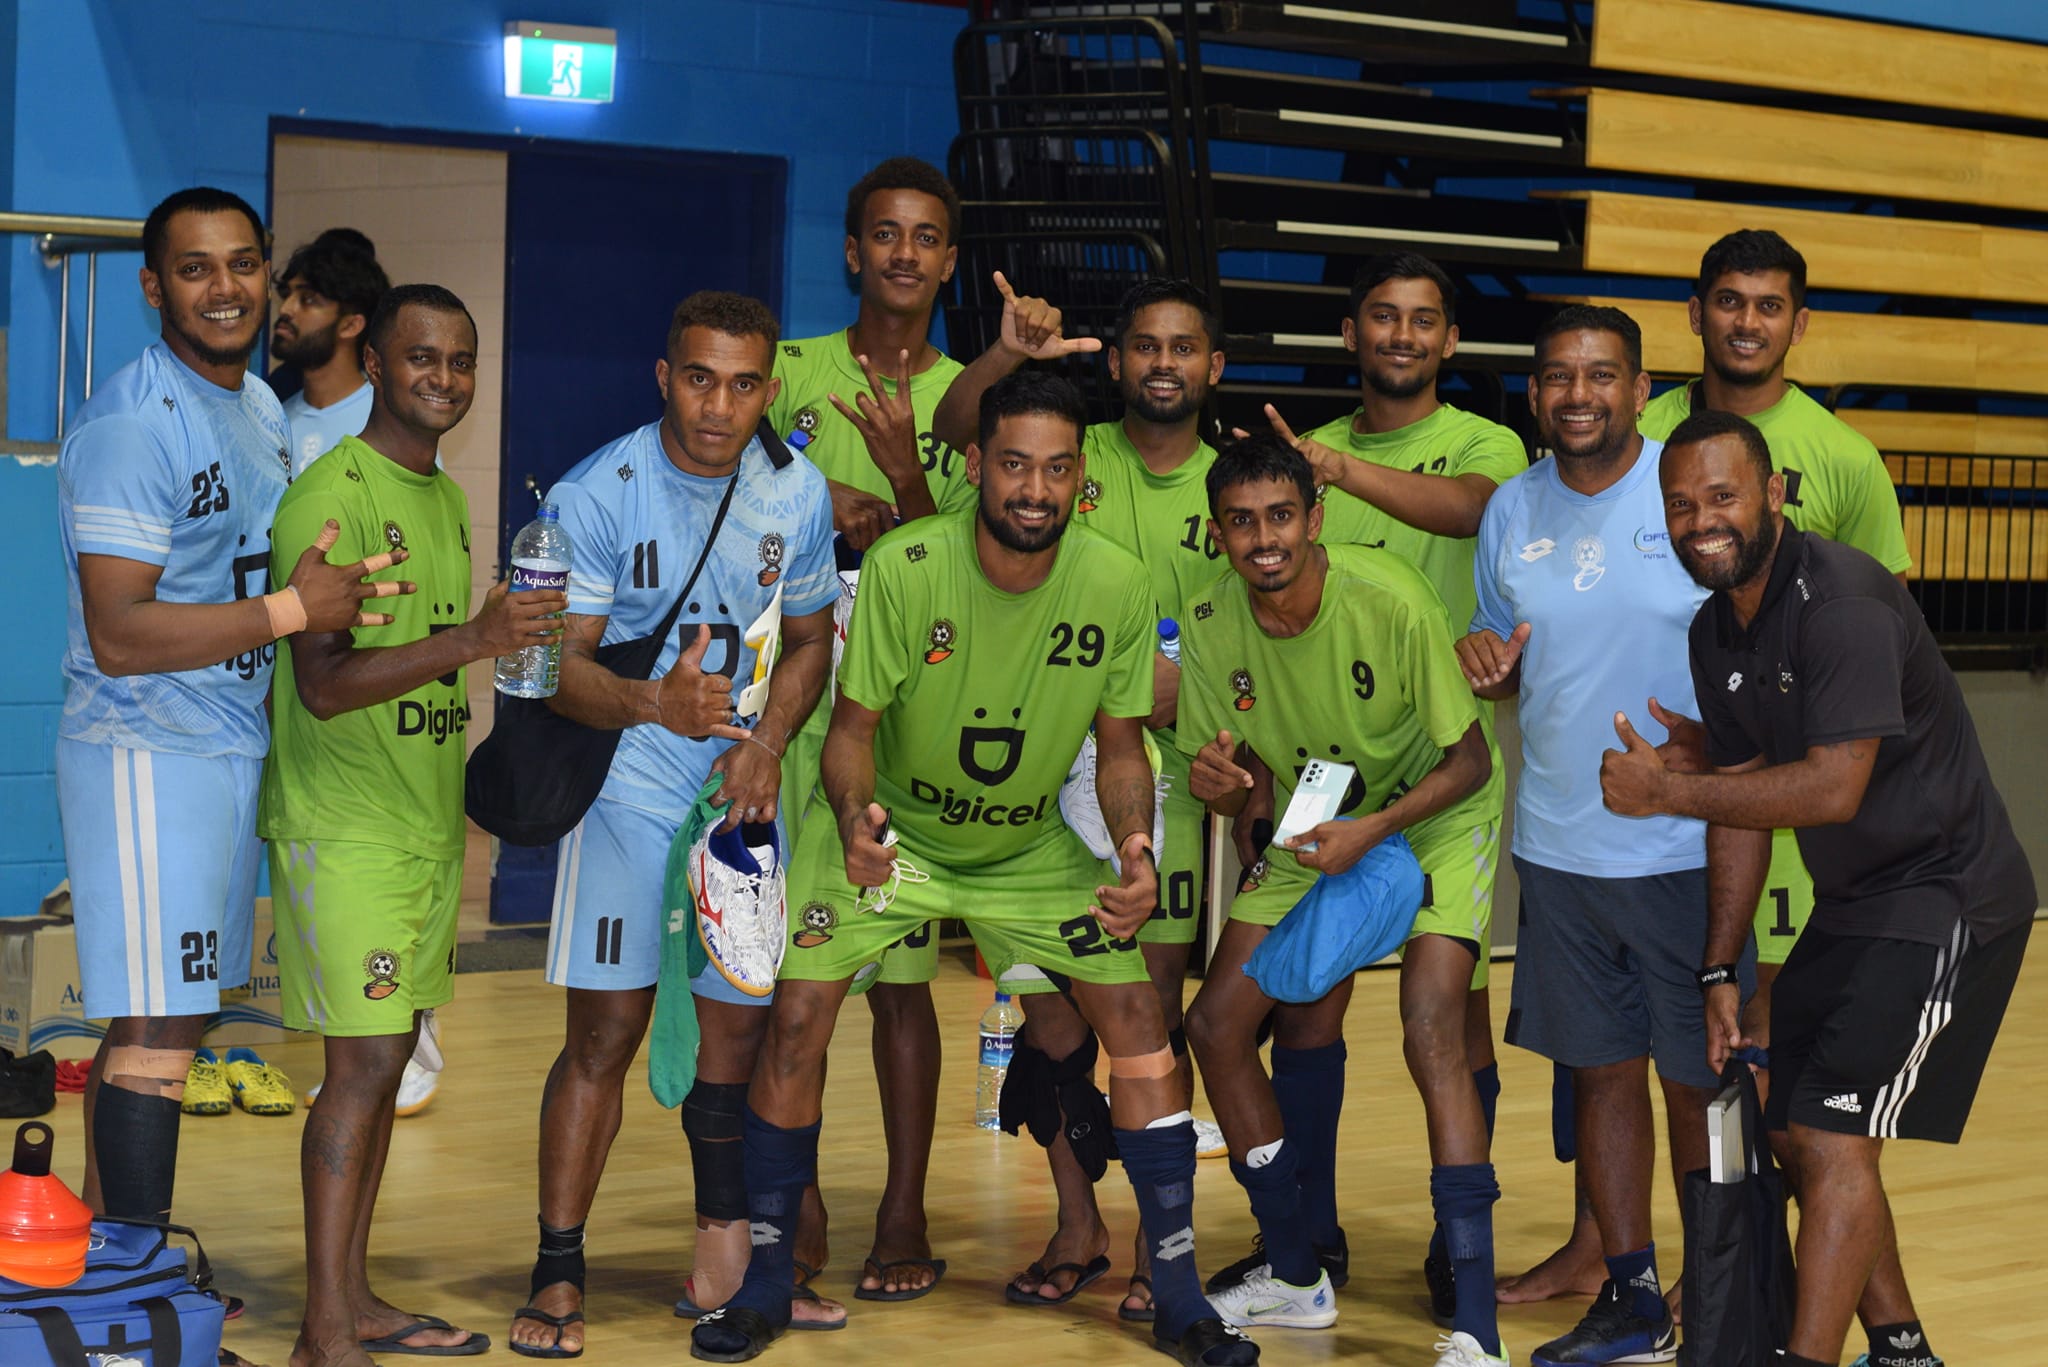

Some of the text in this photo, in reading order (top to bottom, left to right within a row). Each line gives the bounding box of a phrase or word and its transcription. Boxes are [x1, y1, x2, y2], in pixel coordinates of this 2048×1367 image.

[186, 461, 229, 518] 23
[633, 540, 659, 588] 11
[905, 542, 928, 560] PGL
[522, 574, 565, 589] AquaSafe
[1194, 601, 1214, 618] PGL
[1046, 622, 1105, 668] 29
[1351, 660, 1375, 700] 9
[911, 777, 1048, 826] Digicel
[1769, 888, 1796, 936] 1
[181, 930, 218, 983] 23
[595, 916, 623, 965] 11
[1823, 1097, 1862, 1113] adidas
